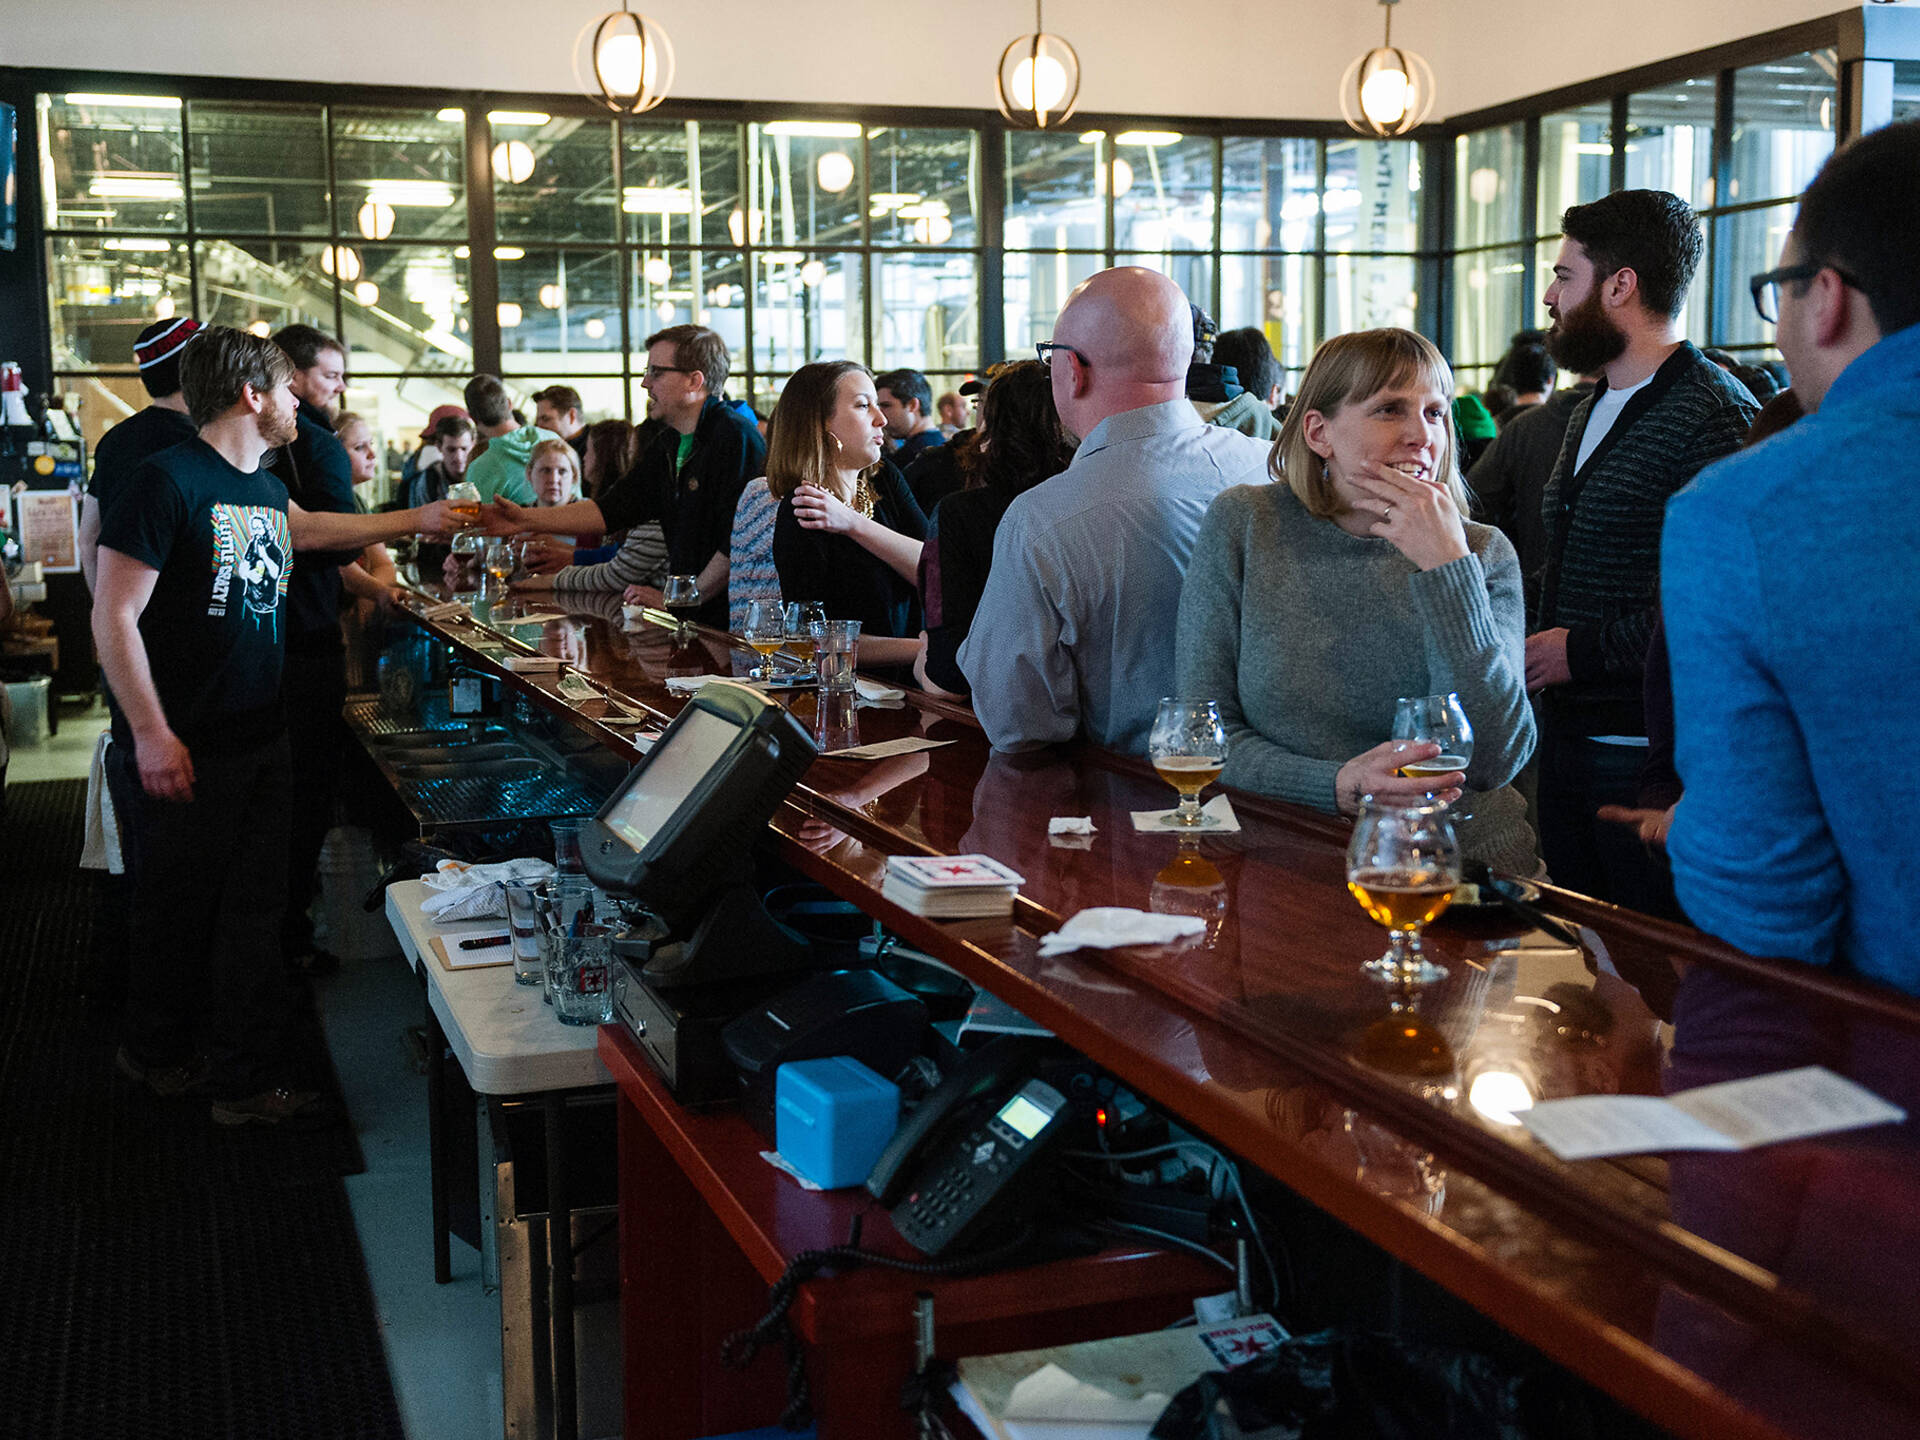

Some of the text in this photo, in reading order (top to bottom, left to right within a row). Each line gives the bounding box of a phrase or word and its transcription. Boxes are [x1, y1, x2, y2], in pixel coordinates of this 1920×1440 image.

[1370, 140, 1393, 260] ANTI-HER
[218, 511, 230, 521] A
[220, 524, 235, 563] LITTLE
[212, 565, 233, 602] CRAZY
